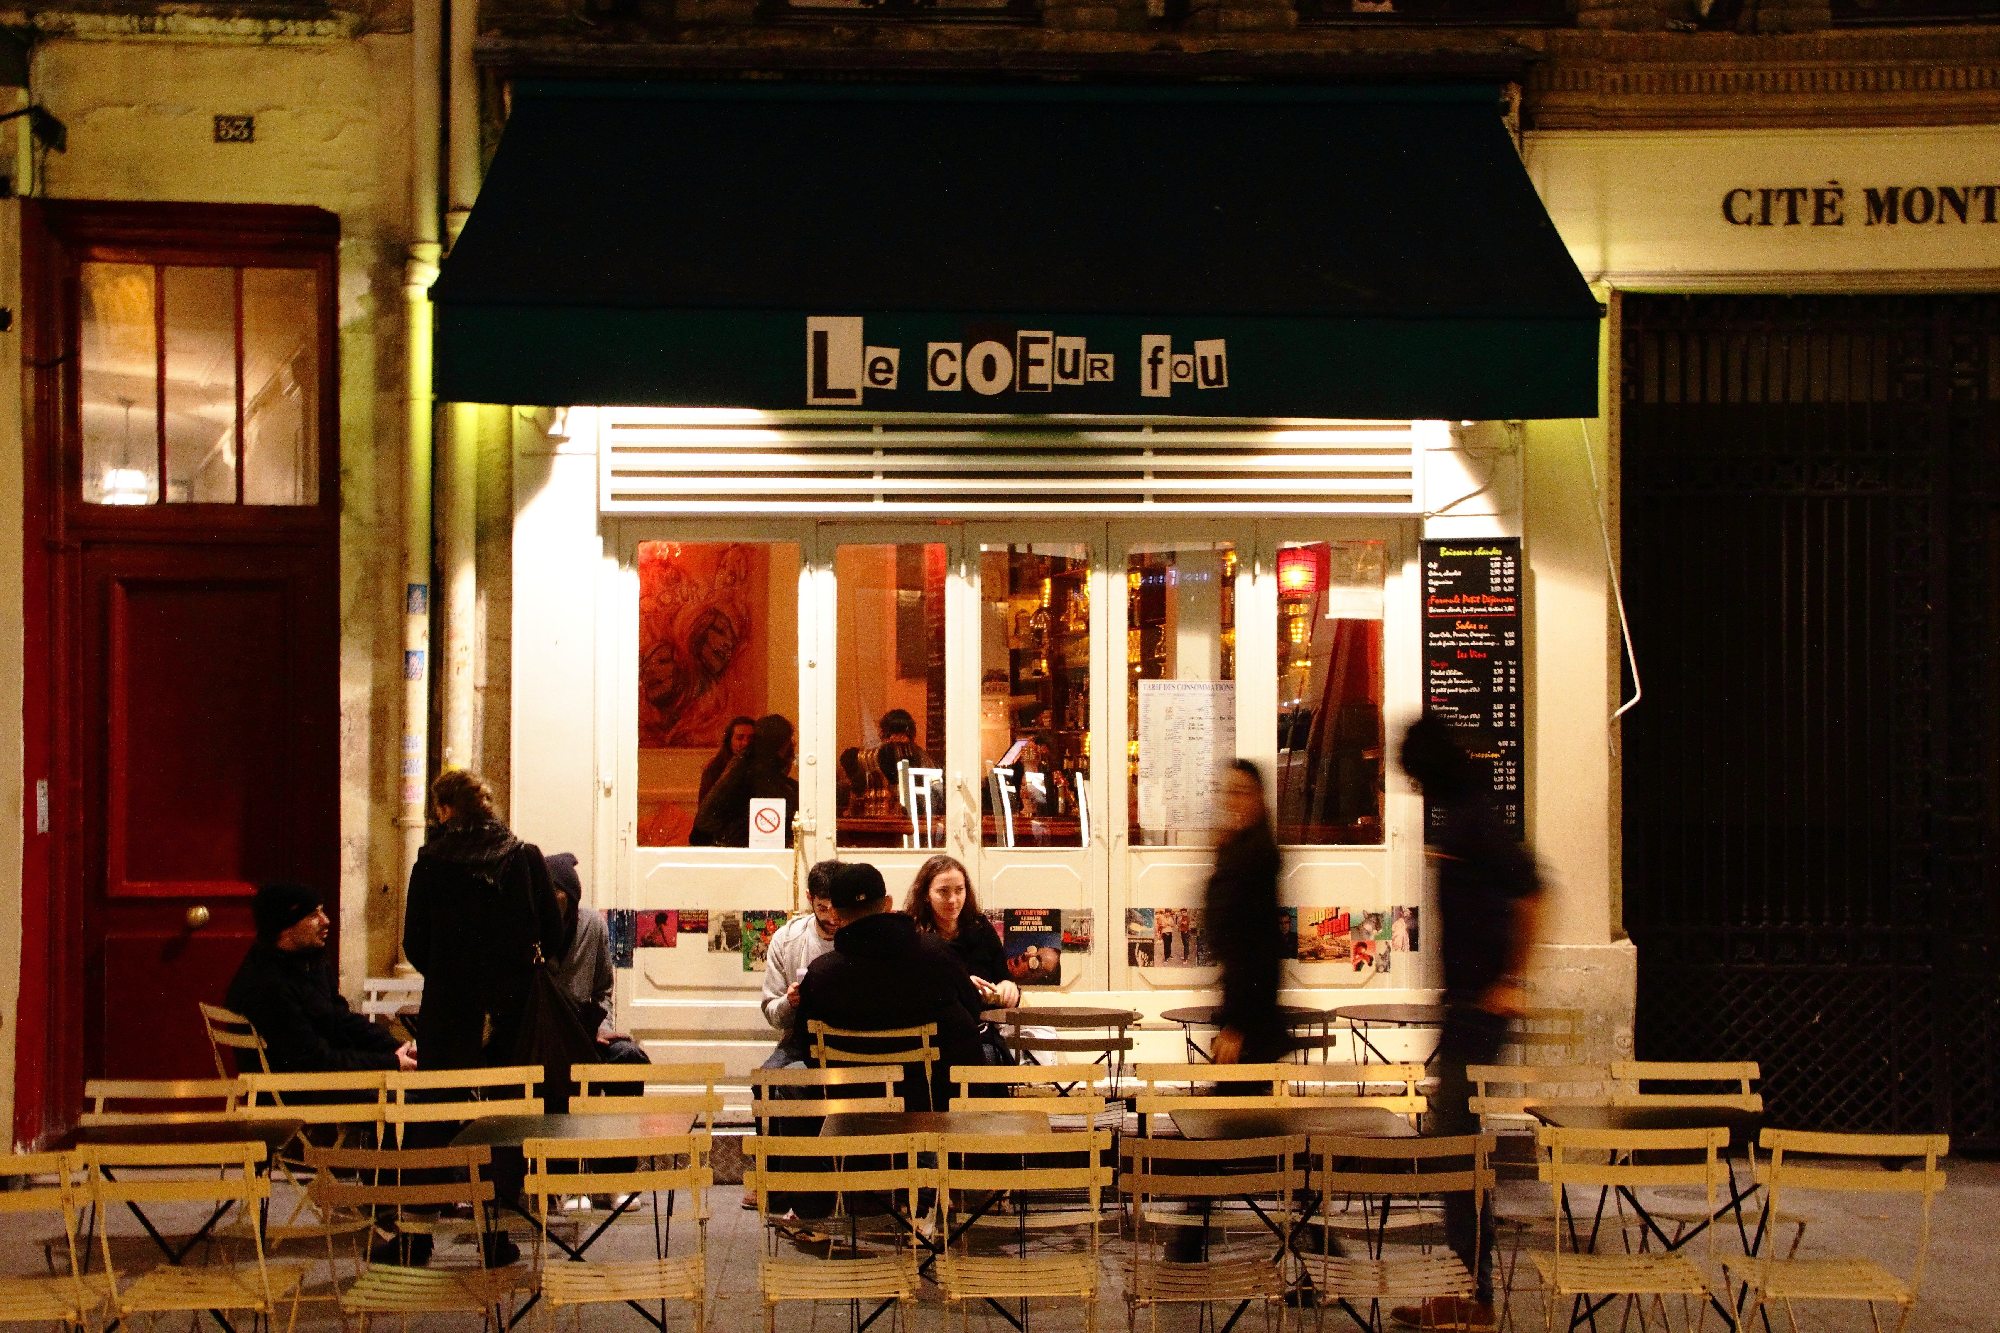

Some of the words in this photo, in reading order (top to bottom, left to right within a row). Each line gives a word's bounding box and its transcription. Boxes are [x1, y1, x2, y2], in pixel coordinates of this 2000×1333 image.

[219, 119, 250, 140] 53
[1721, 179, 1844, 227] CITÉ
[811, 325, 896, 402] Le
